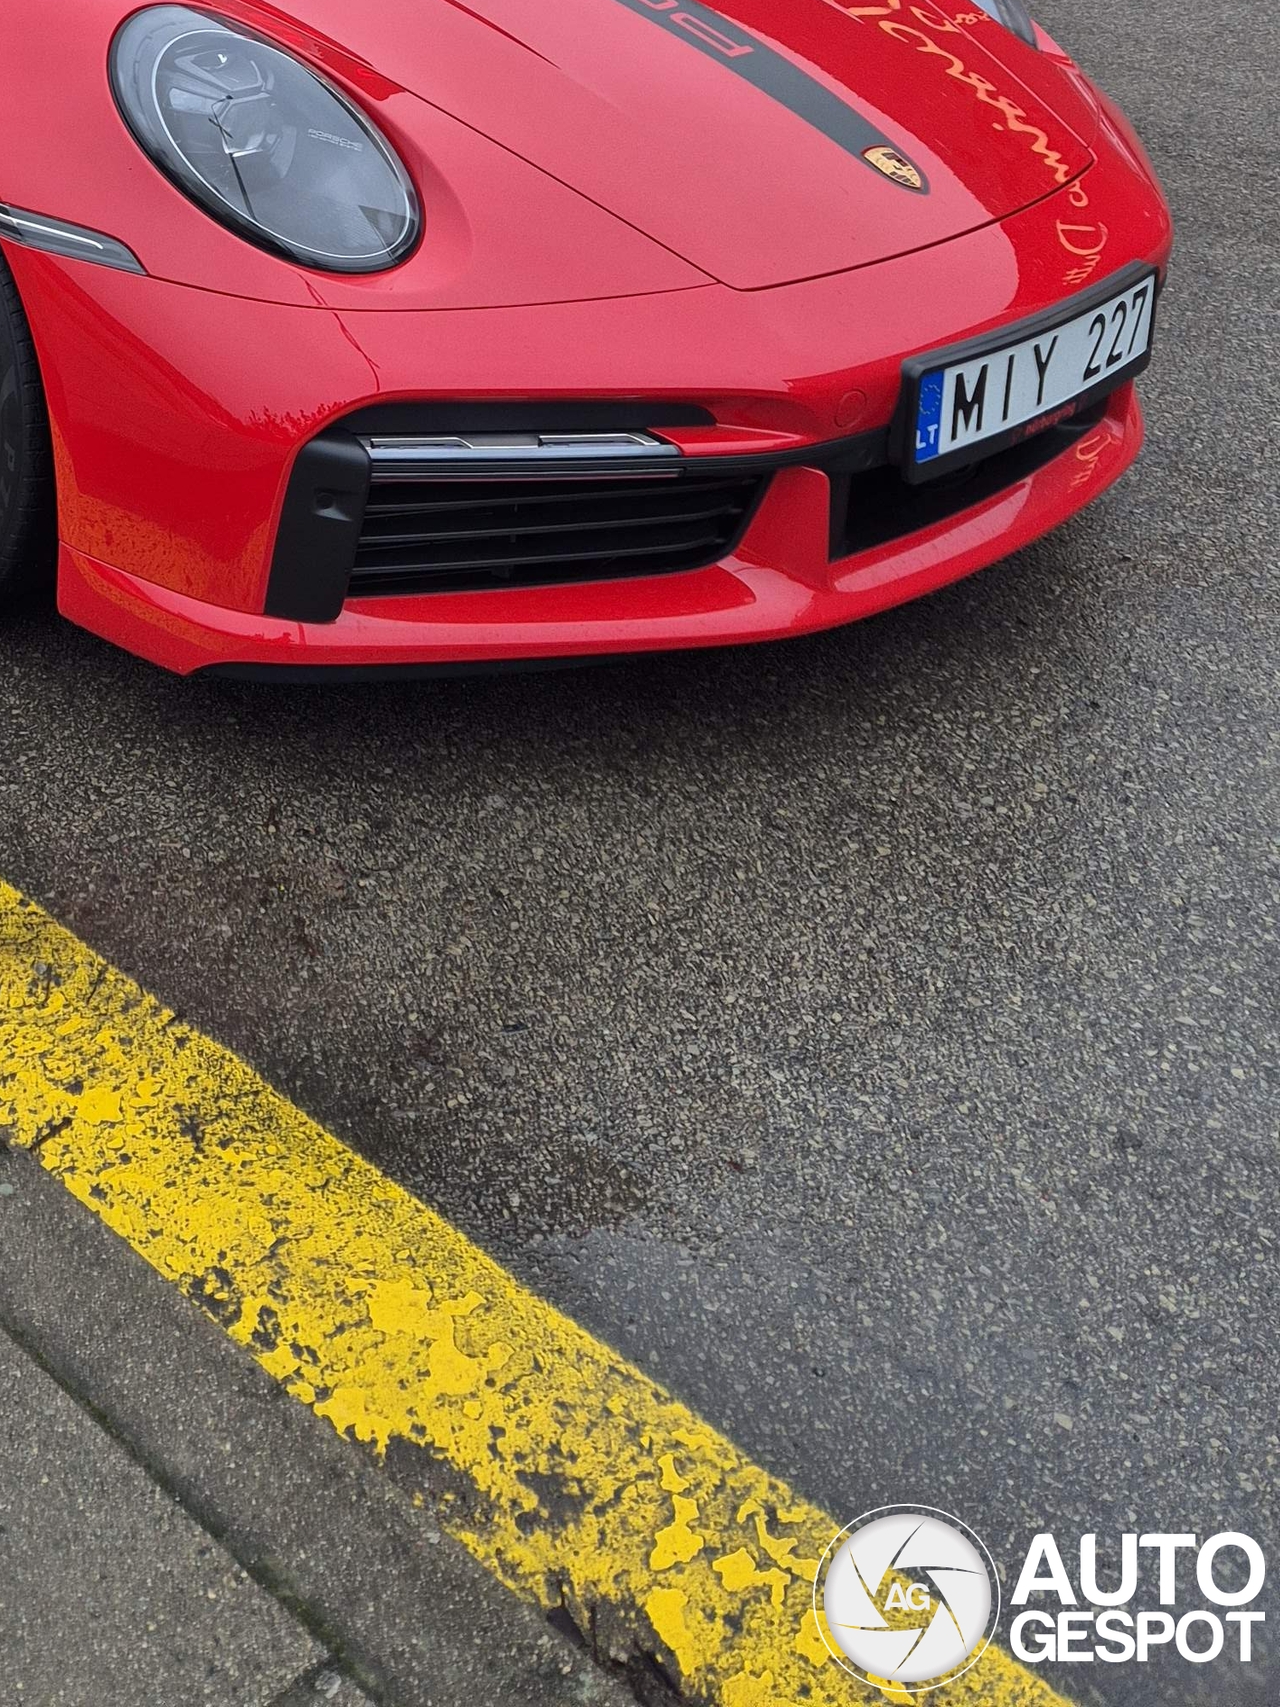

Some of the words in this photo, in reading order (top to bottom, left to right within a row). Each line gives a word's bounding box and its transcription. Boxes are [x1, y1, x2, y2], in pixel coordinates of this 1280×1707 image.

[950, 334, 1059, 442] MIY
[1083, 284, 1149, 383] 227
[915, 423, 939, 449] LT
